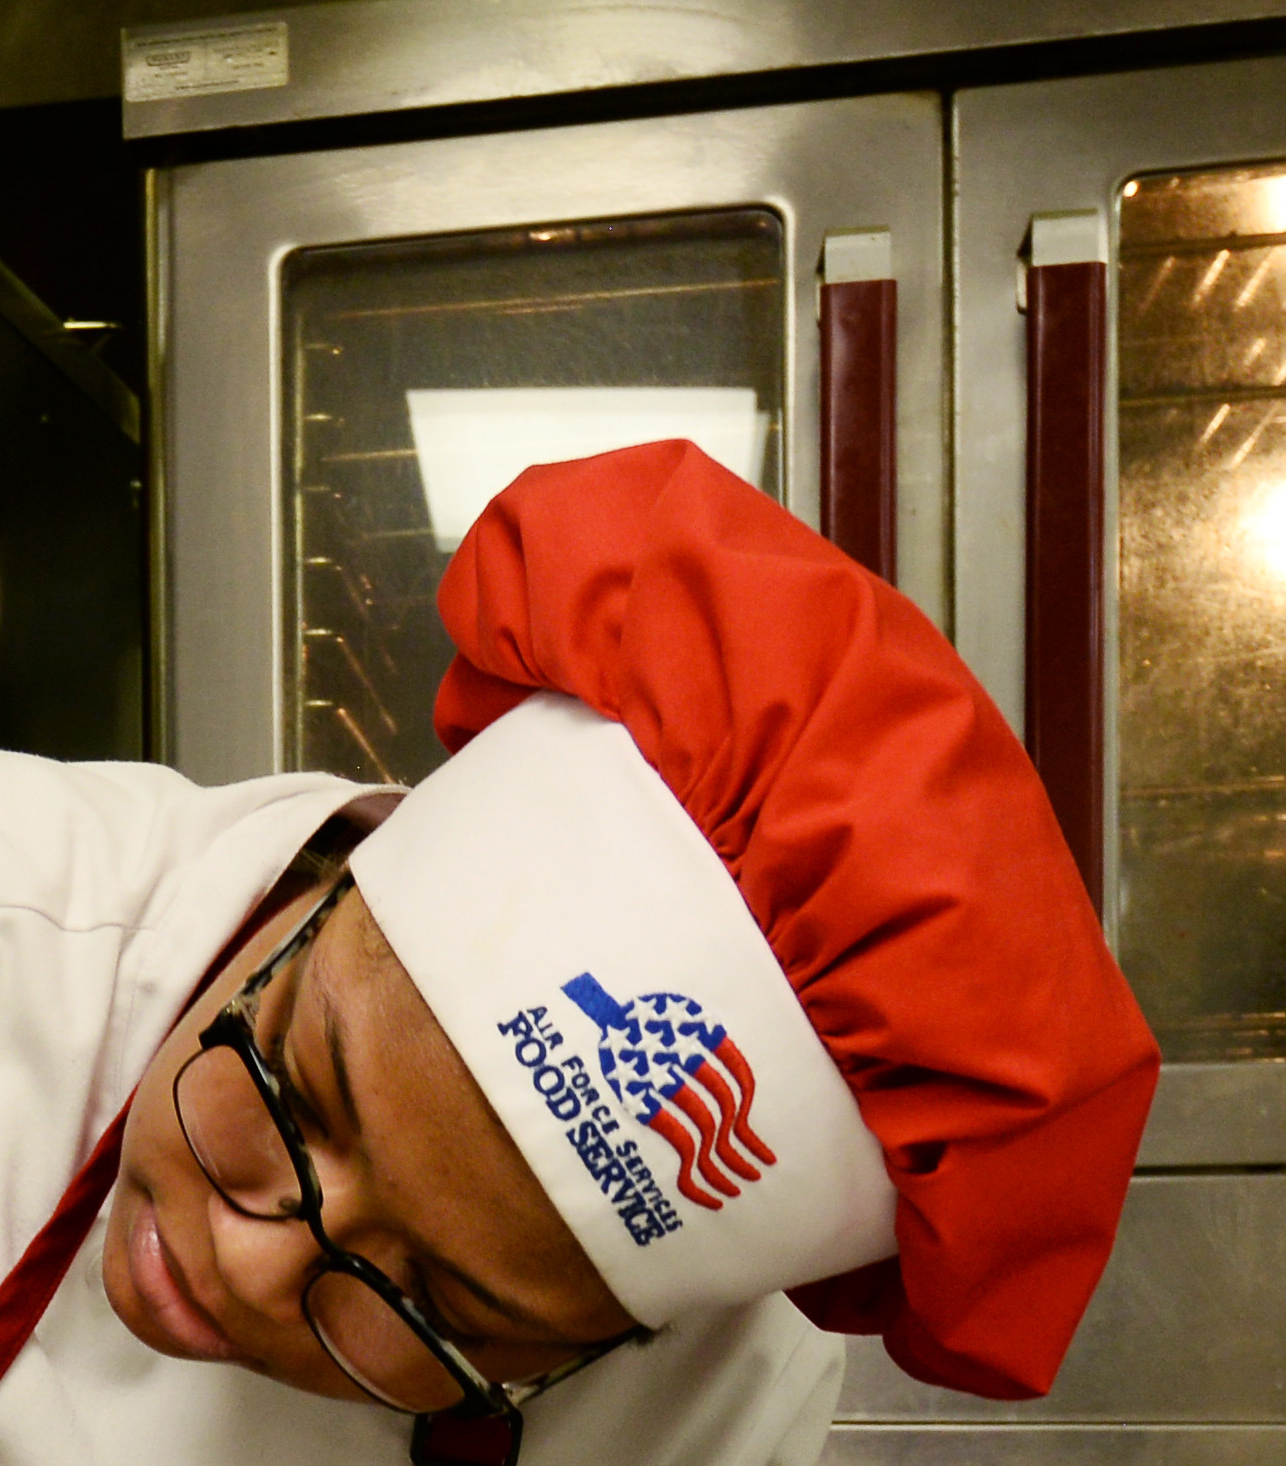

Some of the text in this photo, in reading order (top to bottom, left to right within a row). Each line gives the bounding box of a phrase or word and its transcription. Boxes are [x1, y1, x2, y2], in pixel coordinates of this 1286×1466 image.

[497, 1011, 666, 1247] FOOD SERVICE
[526, 1006, 683, 1233] AIR FORCE SERVICES
